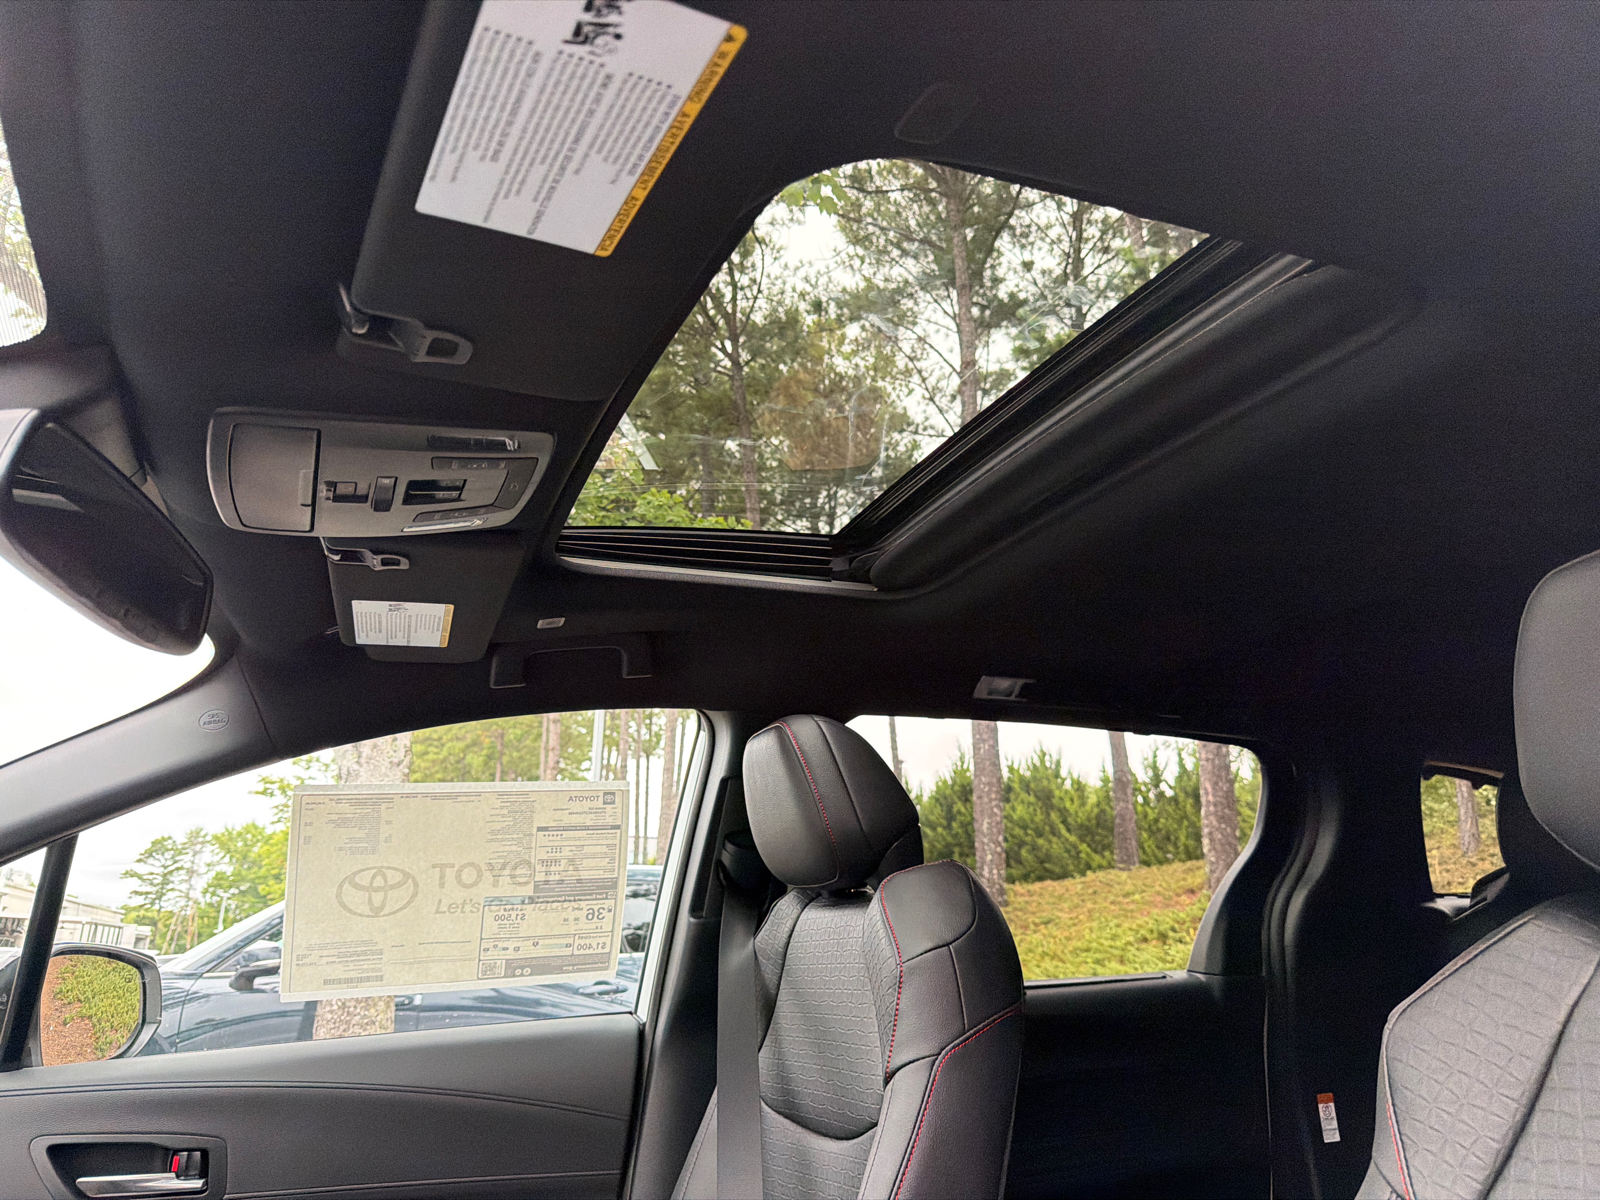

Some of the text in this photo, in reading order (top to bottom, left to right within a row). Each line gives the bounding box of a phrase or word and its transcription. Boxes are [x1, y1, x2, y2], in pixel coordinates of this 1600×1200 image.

[641, 111, 691, 192] AVERTISSEMENT
[601, 195, 640, 251] ADVERTENCIA
[434, 898, 481, 915] Let's
